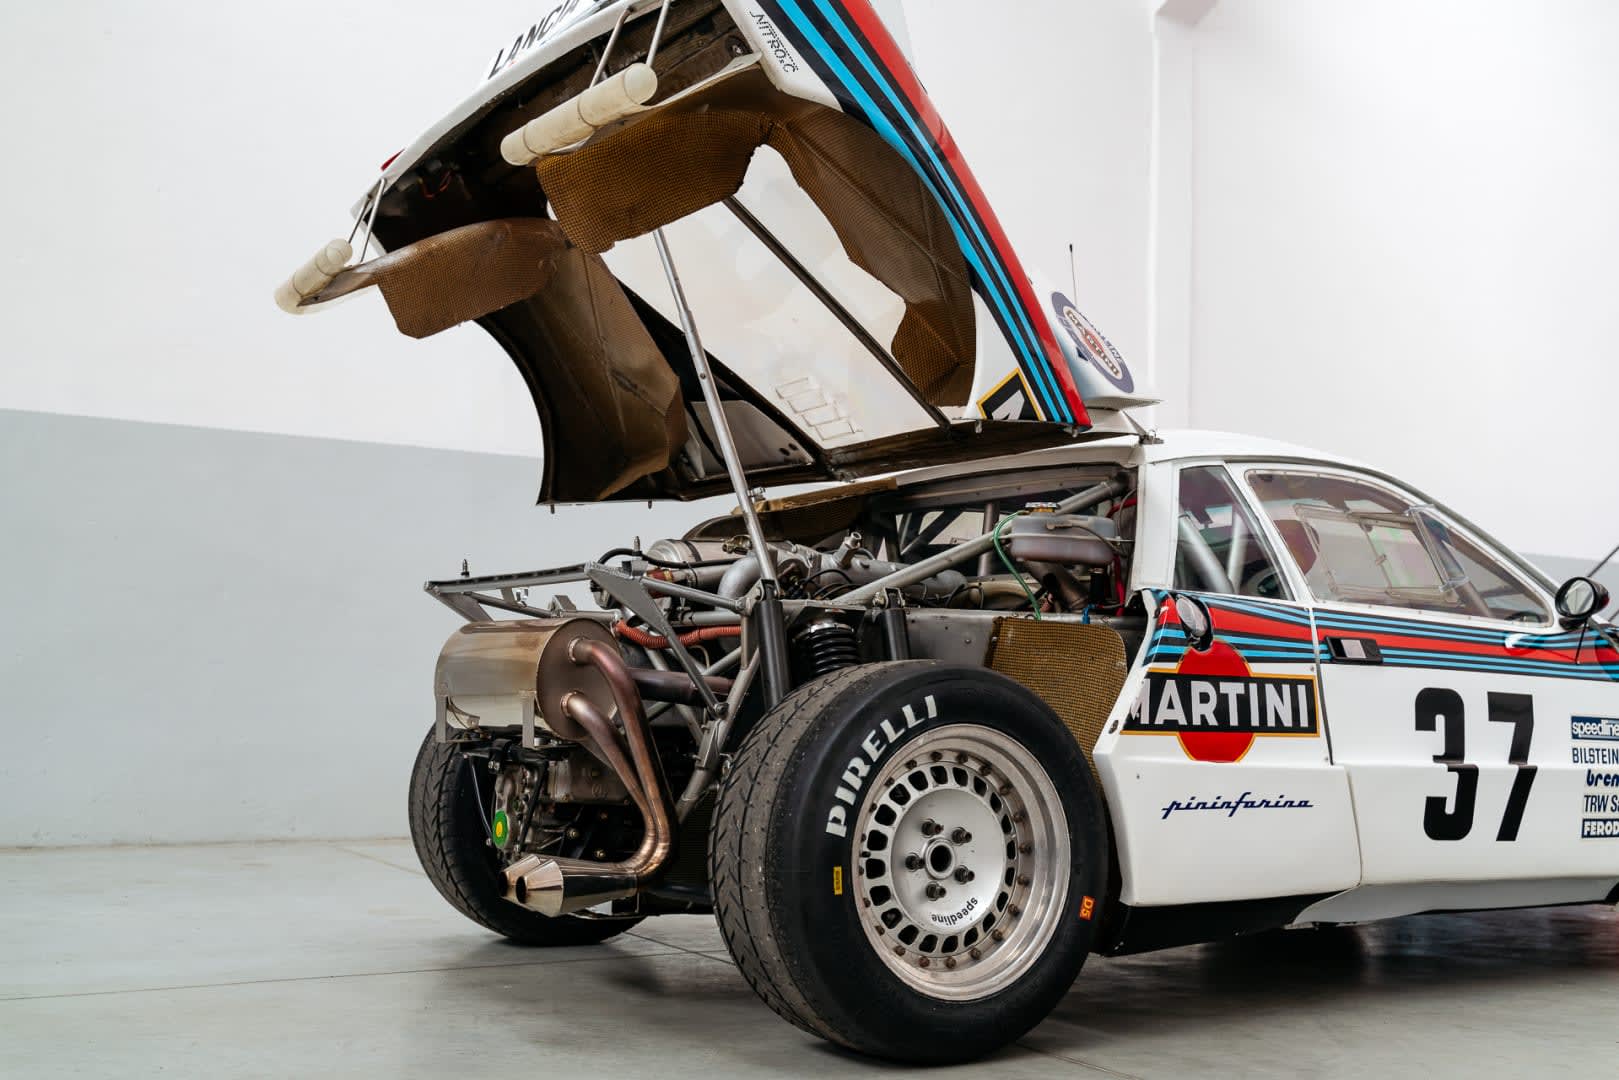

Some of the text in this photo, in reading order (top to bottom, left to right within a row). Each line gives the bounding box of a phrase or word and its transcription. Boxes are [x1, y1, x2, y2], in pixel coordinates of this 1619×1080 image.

[826, 695, 938, 838] PIRELLI
[1415, 687, 1538, 842] 37
[1161, 792, 1313, 820] pininfarina
[1584, 795, 1608, 813] TRW
[931, 898, 978, 926] speedline
[1079, 896, 1095, 920] D5
